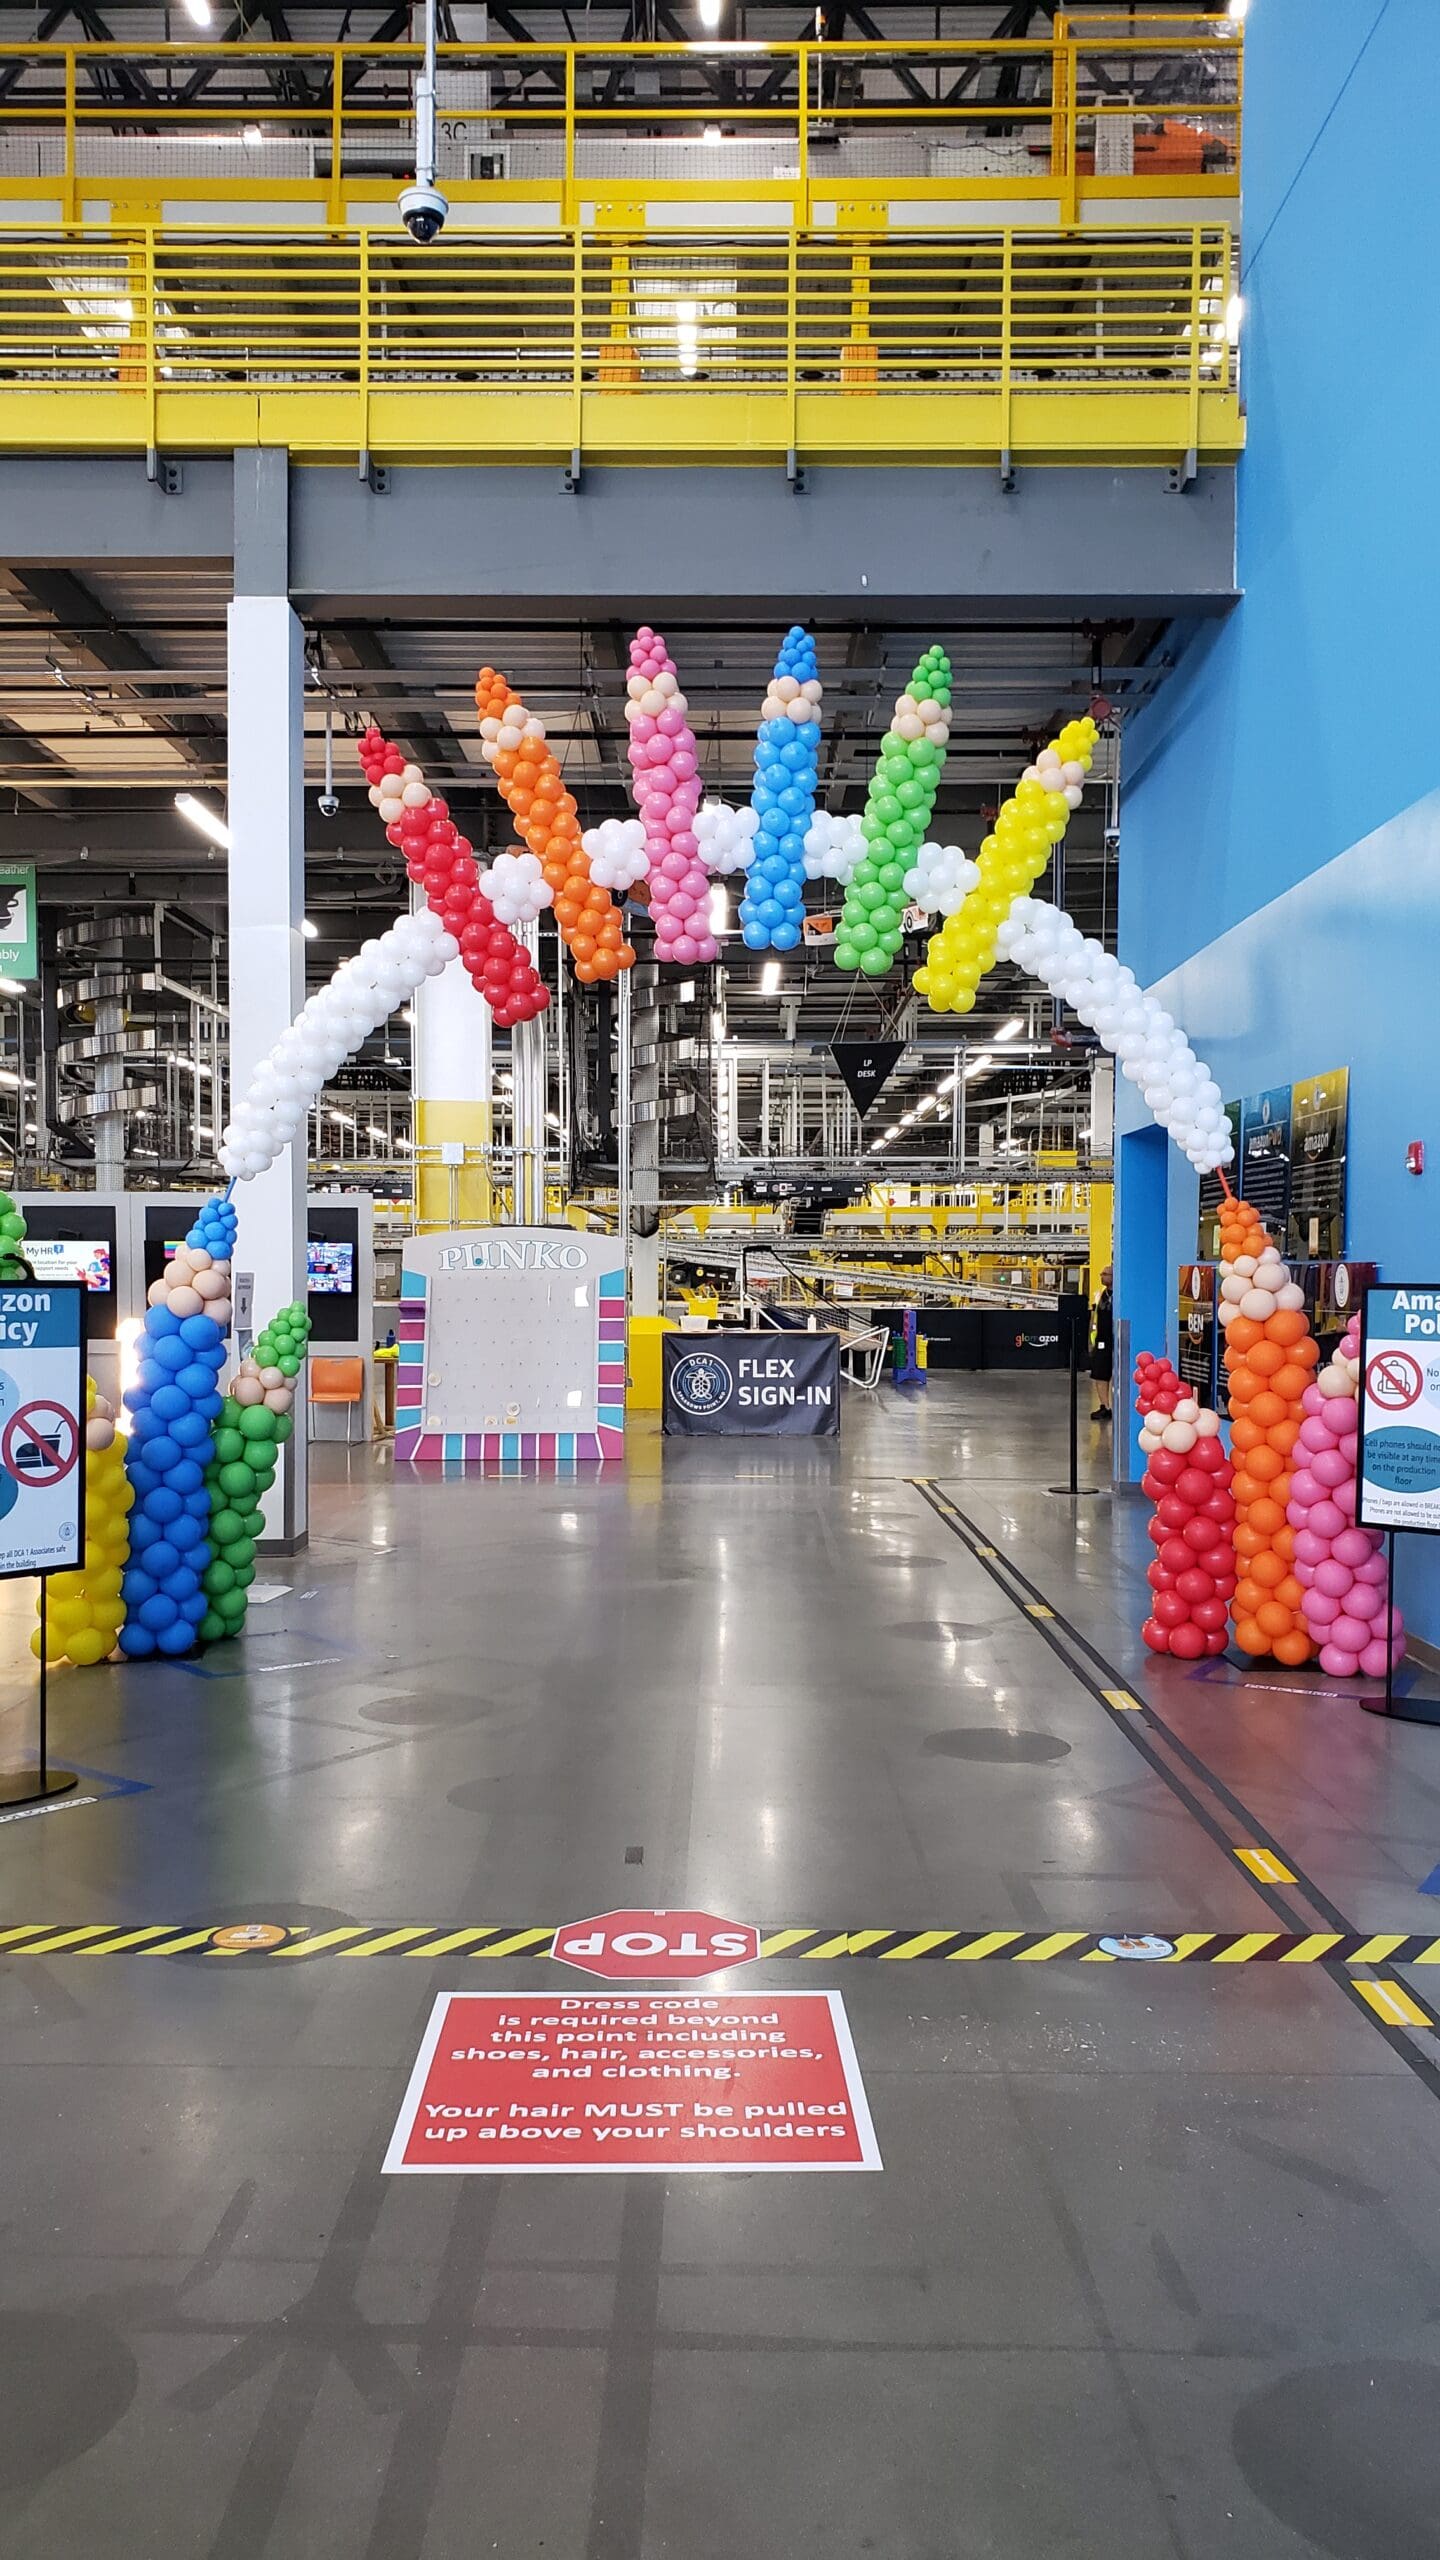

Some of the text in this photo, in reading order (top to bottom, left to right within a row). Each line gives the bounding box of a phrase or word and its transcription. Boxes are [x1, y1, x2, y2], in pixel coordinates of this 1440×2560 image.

[863, 1059, 873, 1067] LP
[857, 1070, 877, 1078] DESK
[26, 1247, 53, 1257] My HR
[439, 1240, 588, 1270] PLINKO
[1187, 1313, 1204, 1333] BEN
[688, 1356, 714, 1367] DCA1
[738, 1359, 795, 1378] FLEX
[1426, 1367, 1440, 1378] No
[738, 1386, 832, 1406] SIGN-IN
[1365, 1438, 1378, 1447] Cell
[1380, 1439, 1406, 1449] phones
[1407, 1441, 1432, 1451] should
[1367, 1451, 1376, 1459] be
[1377, 1451, 1400, 1460] visible
[1411, 1455, 1424, 1464] any
[1372, 1463, 1436, 1475] on the production
[1394, 1475, 1413, 1485] floor
[14, 1548, 25, 1558] DCA
[563, 1931, 749, 1957] STOP
[561, 1999, 719, 2010] Dress code
[499, 2013, 779, 2028] is required beyond
[491, 2029, 786, 2045] this point including
[451, 2047, 823, 2062] shoes, hair, accessories,
[532, 2064, 741, 2080] and clothing.
[425, 2102, 848, 2119] Your hair MUST be pulled
[425, 2122, 846, 2142] up above your shoulders
